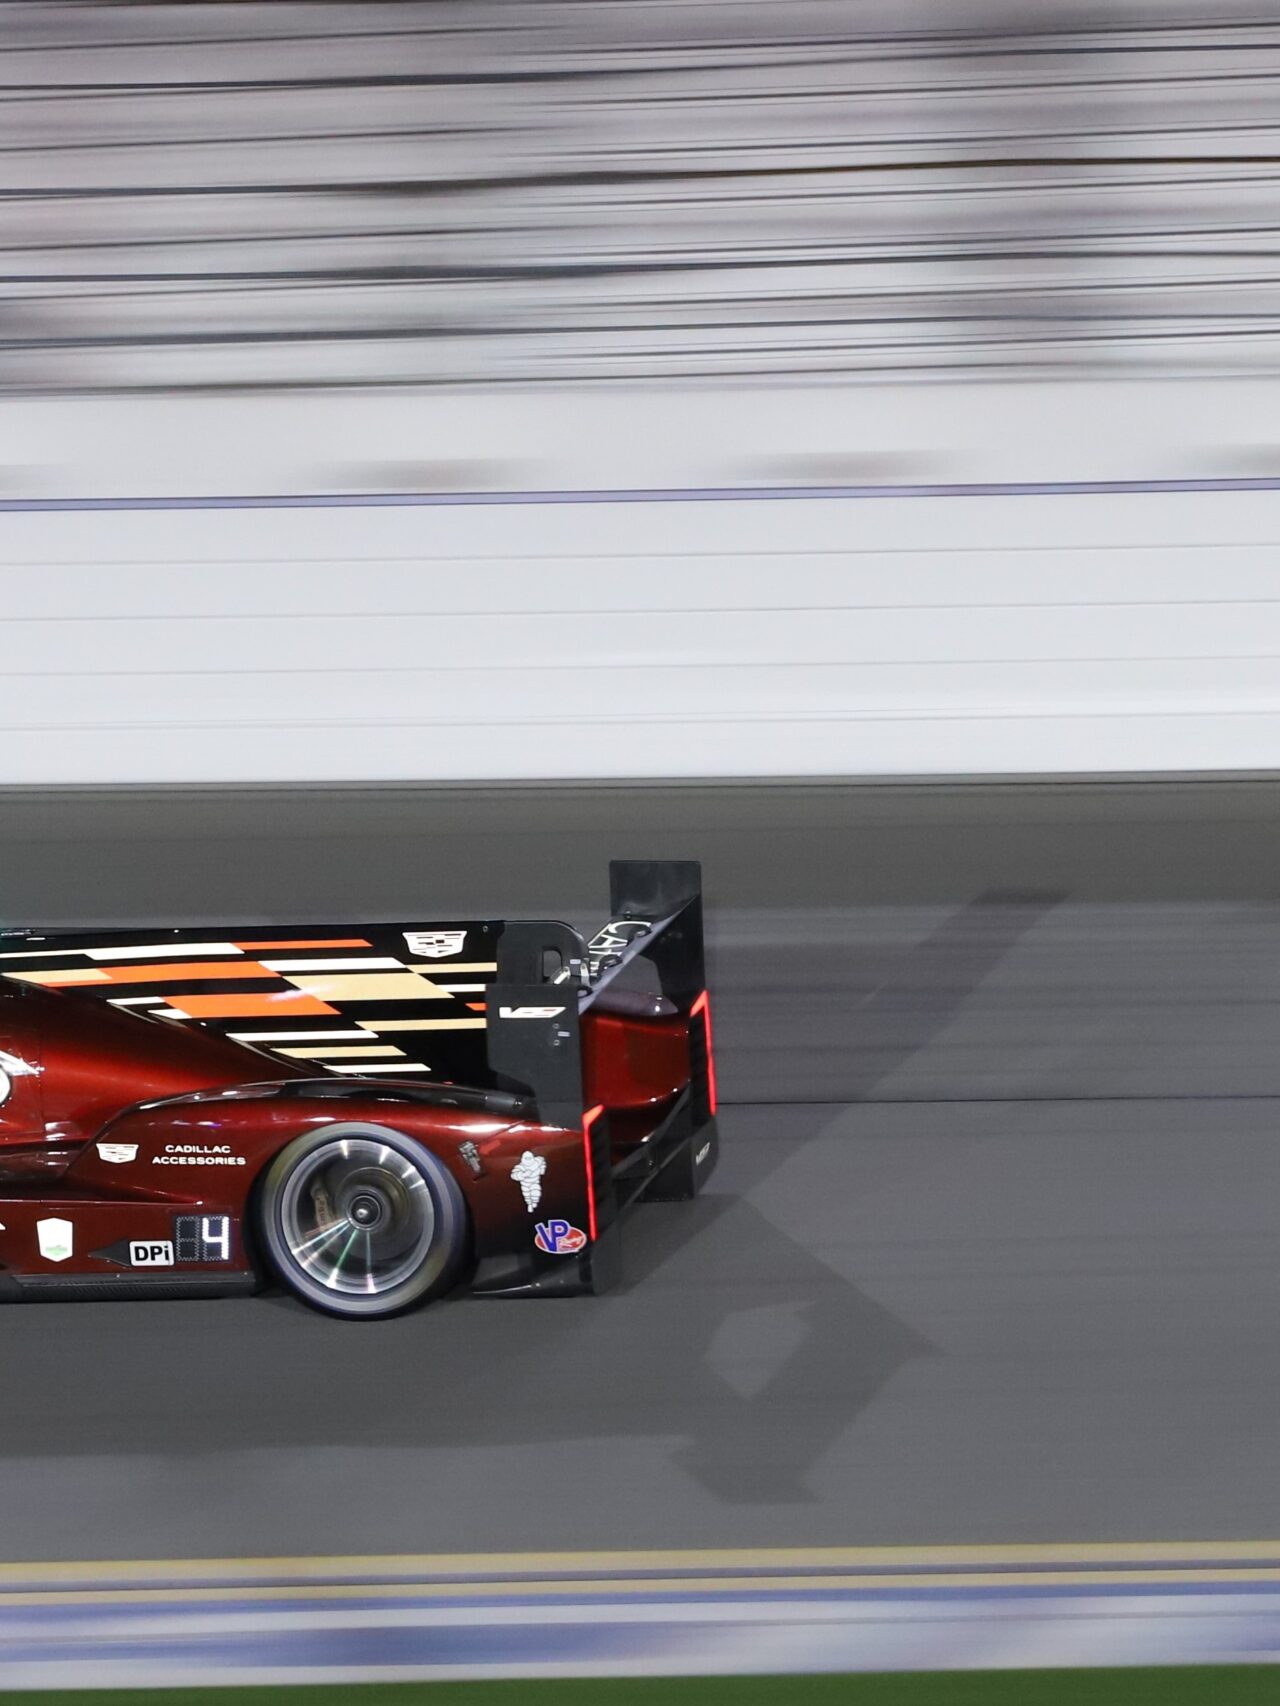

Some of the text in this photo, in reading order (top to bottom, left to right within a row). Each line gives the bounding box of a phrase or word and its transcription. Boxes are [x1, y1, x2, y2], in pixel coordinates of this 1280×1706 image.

[165, 1144, 231, 1154] CADILLAC
[151, 1156, 247, 1166] ACCESSORIES
[534, 1219, 571, 1253] VP
[134, 1245, 170, 1262] DPi
